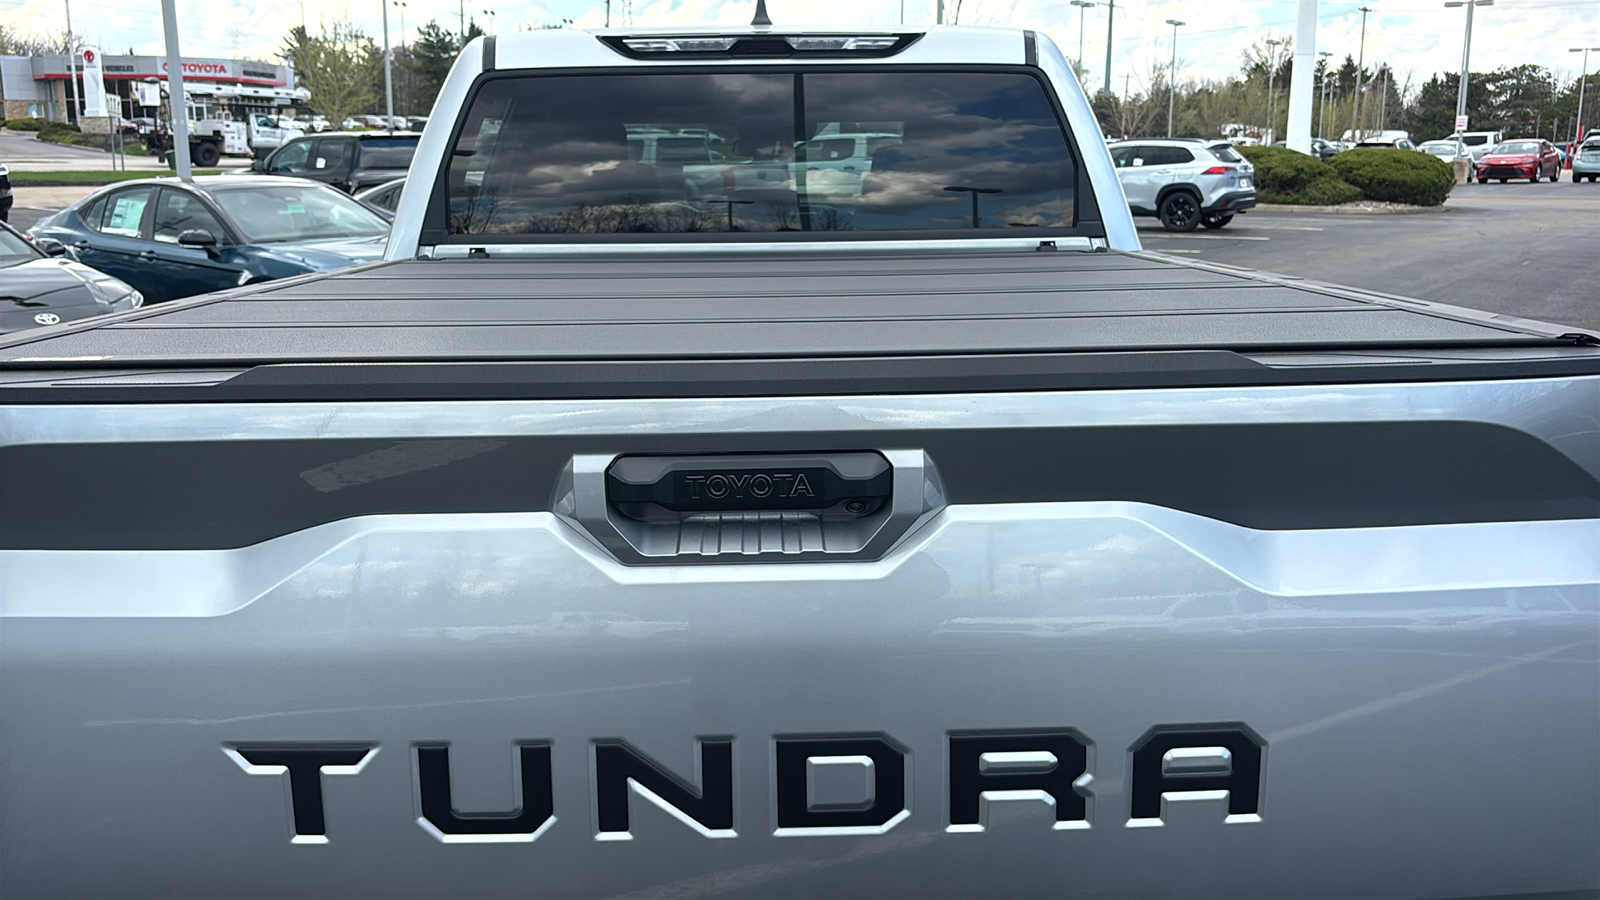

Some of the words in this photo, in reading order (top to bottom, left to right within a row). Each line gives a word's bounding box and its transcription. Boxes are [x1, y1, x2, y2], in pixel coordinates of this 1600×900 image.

[181, 62, 227, 74] TOYOTA
[685, 473, 815, 499] TOYOTA
[221, 721, 1269, 845] TUNDRA
